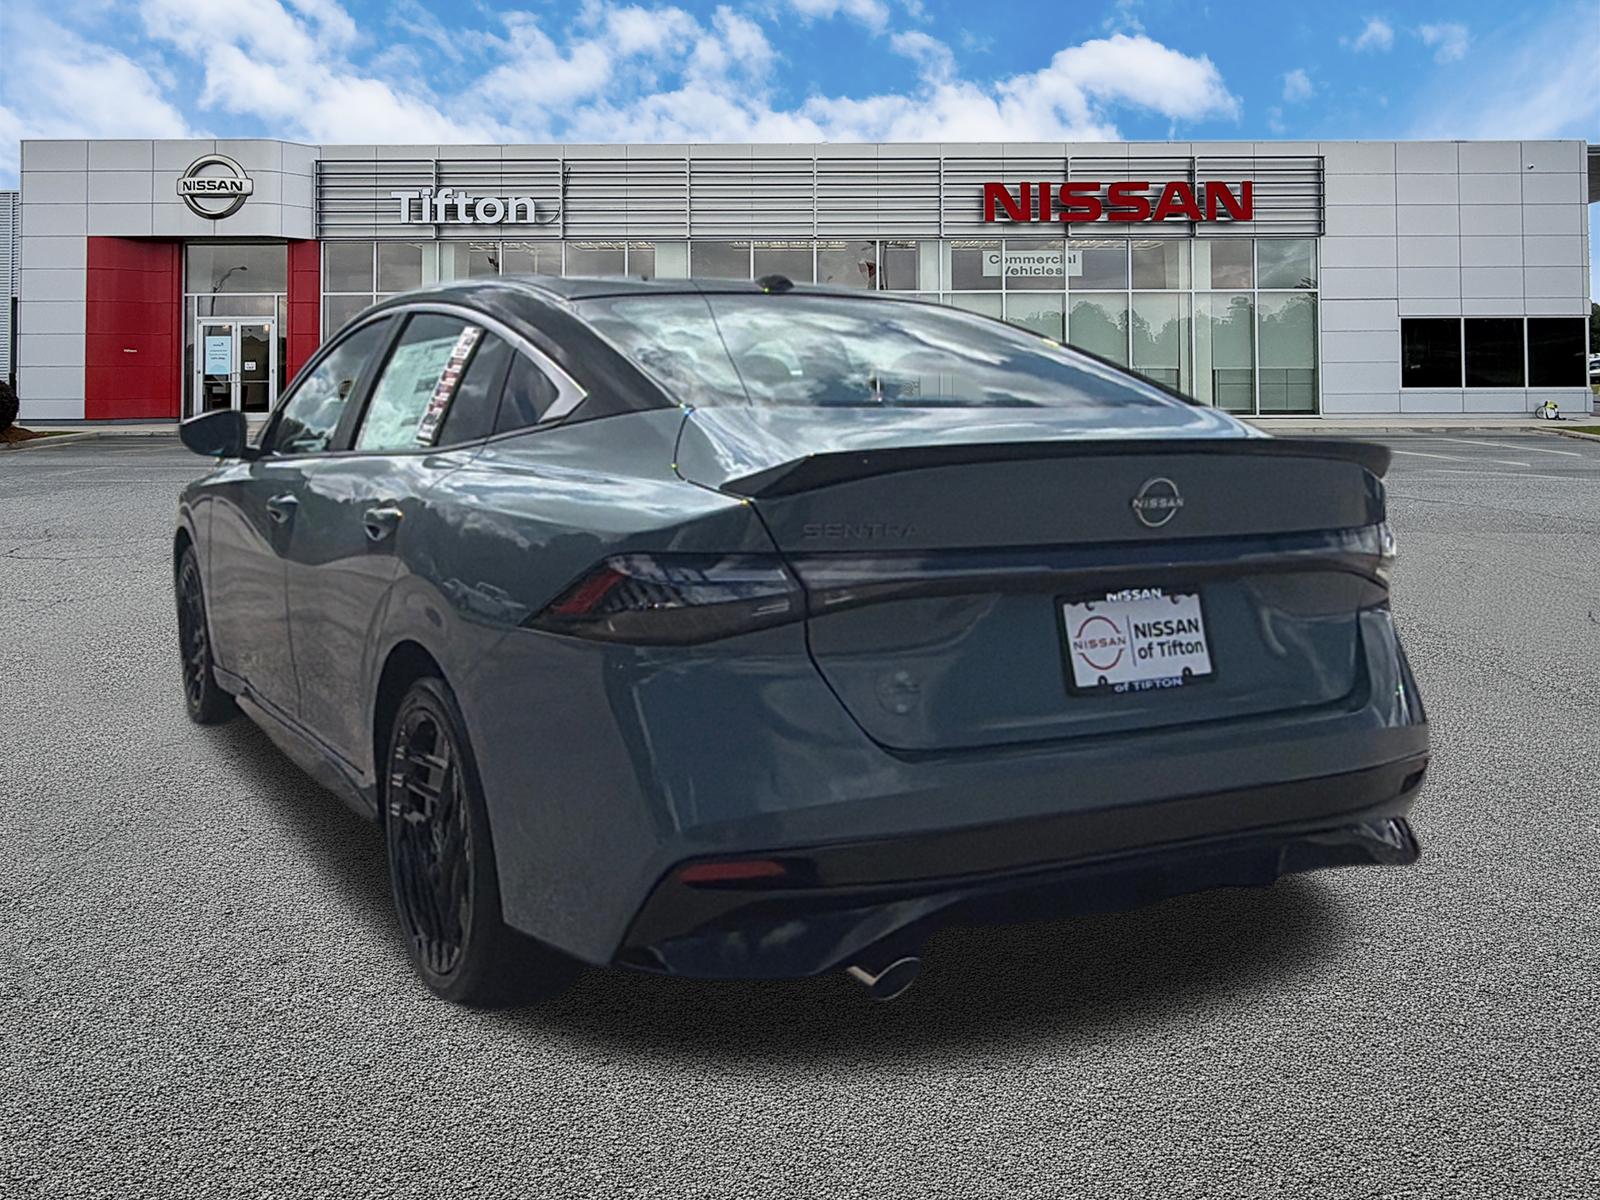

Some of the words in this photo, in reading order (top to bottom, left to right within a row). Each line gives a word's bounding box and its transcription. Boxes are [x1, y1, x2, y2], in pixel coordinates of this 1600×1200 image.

[183, 181, 242, 191] NISSAN
[391, 187, 535, 223] Tifton
[984, 181, 1253, 222] NISSAN
[1132, 498, 1184, 508] NISSAN
[802, 522, 918, 540] SENTRA
[1106, 588, 1162, 601] NISSAN
[1134, 618, 1199, 638] NISSAN
[1073, 636, 1126, 650] NISSAN
[1137, 645, 1153, 660] of
[1157, 641, 1204, 658] Tifton
[1114, 683, 1129, 693] of
[1135, 677, 1183, 690] TIFTON
